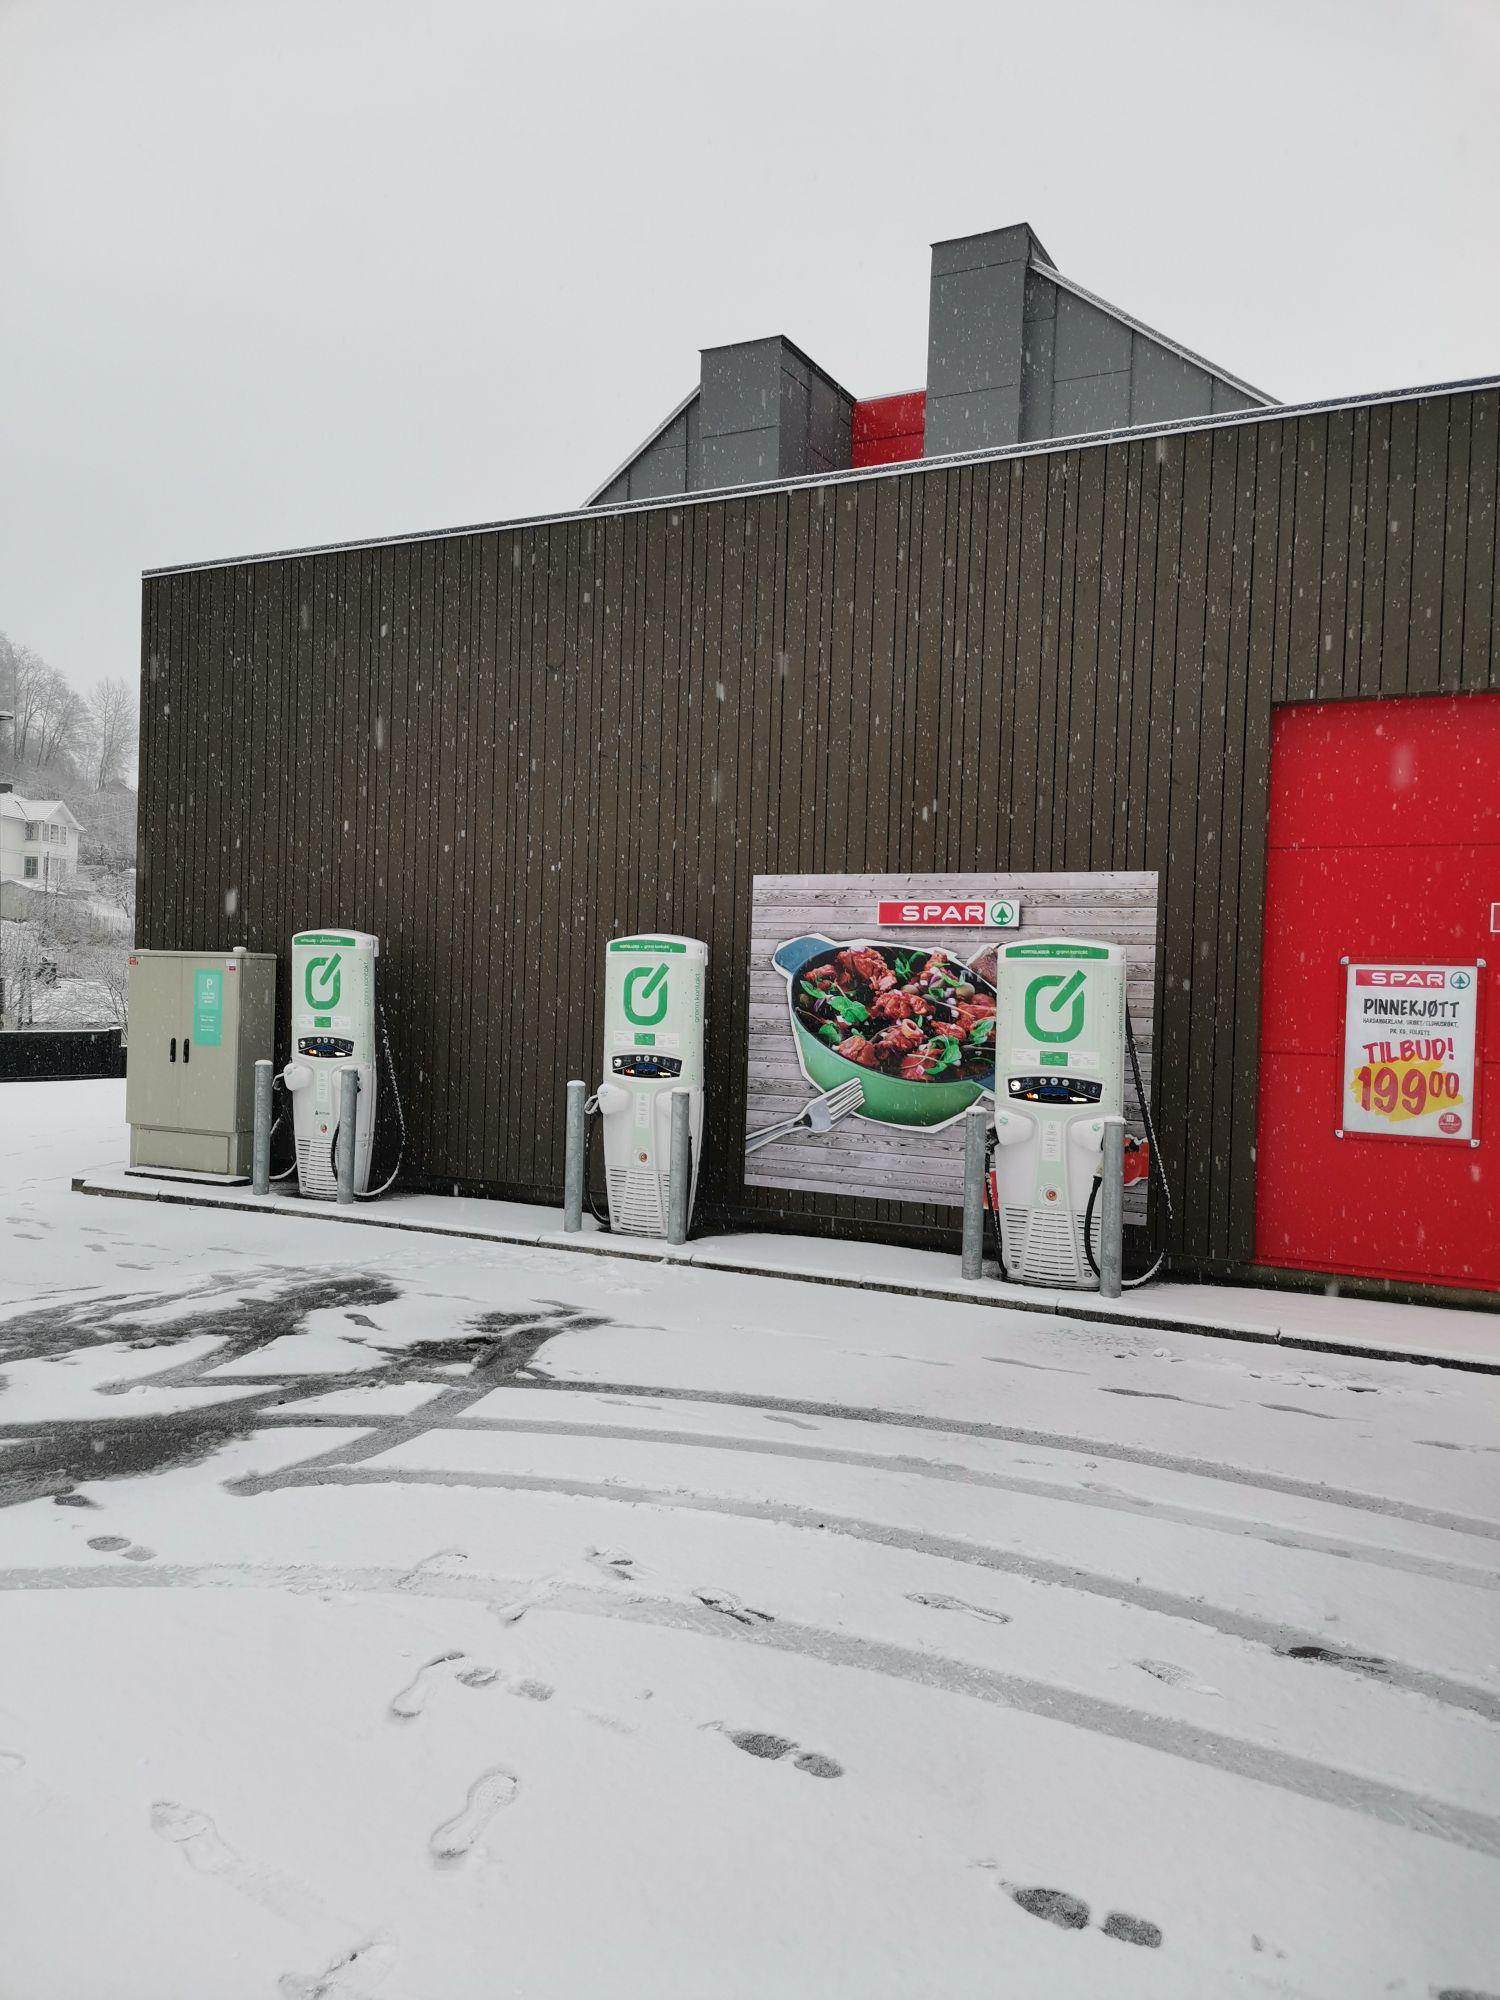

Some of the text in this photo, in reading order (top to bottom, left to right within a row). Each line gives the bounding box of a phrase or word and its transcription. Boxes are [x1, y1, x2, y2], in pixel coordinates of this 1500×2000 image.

[902, 905, 984, 921] SPAR
[1371, 971, 1444, 986] SPAR
[1363, 998, 1460, 1018] PINNEKJØTT
[1362, 1037, 1454, 1064] TILBUD!
